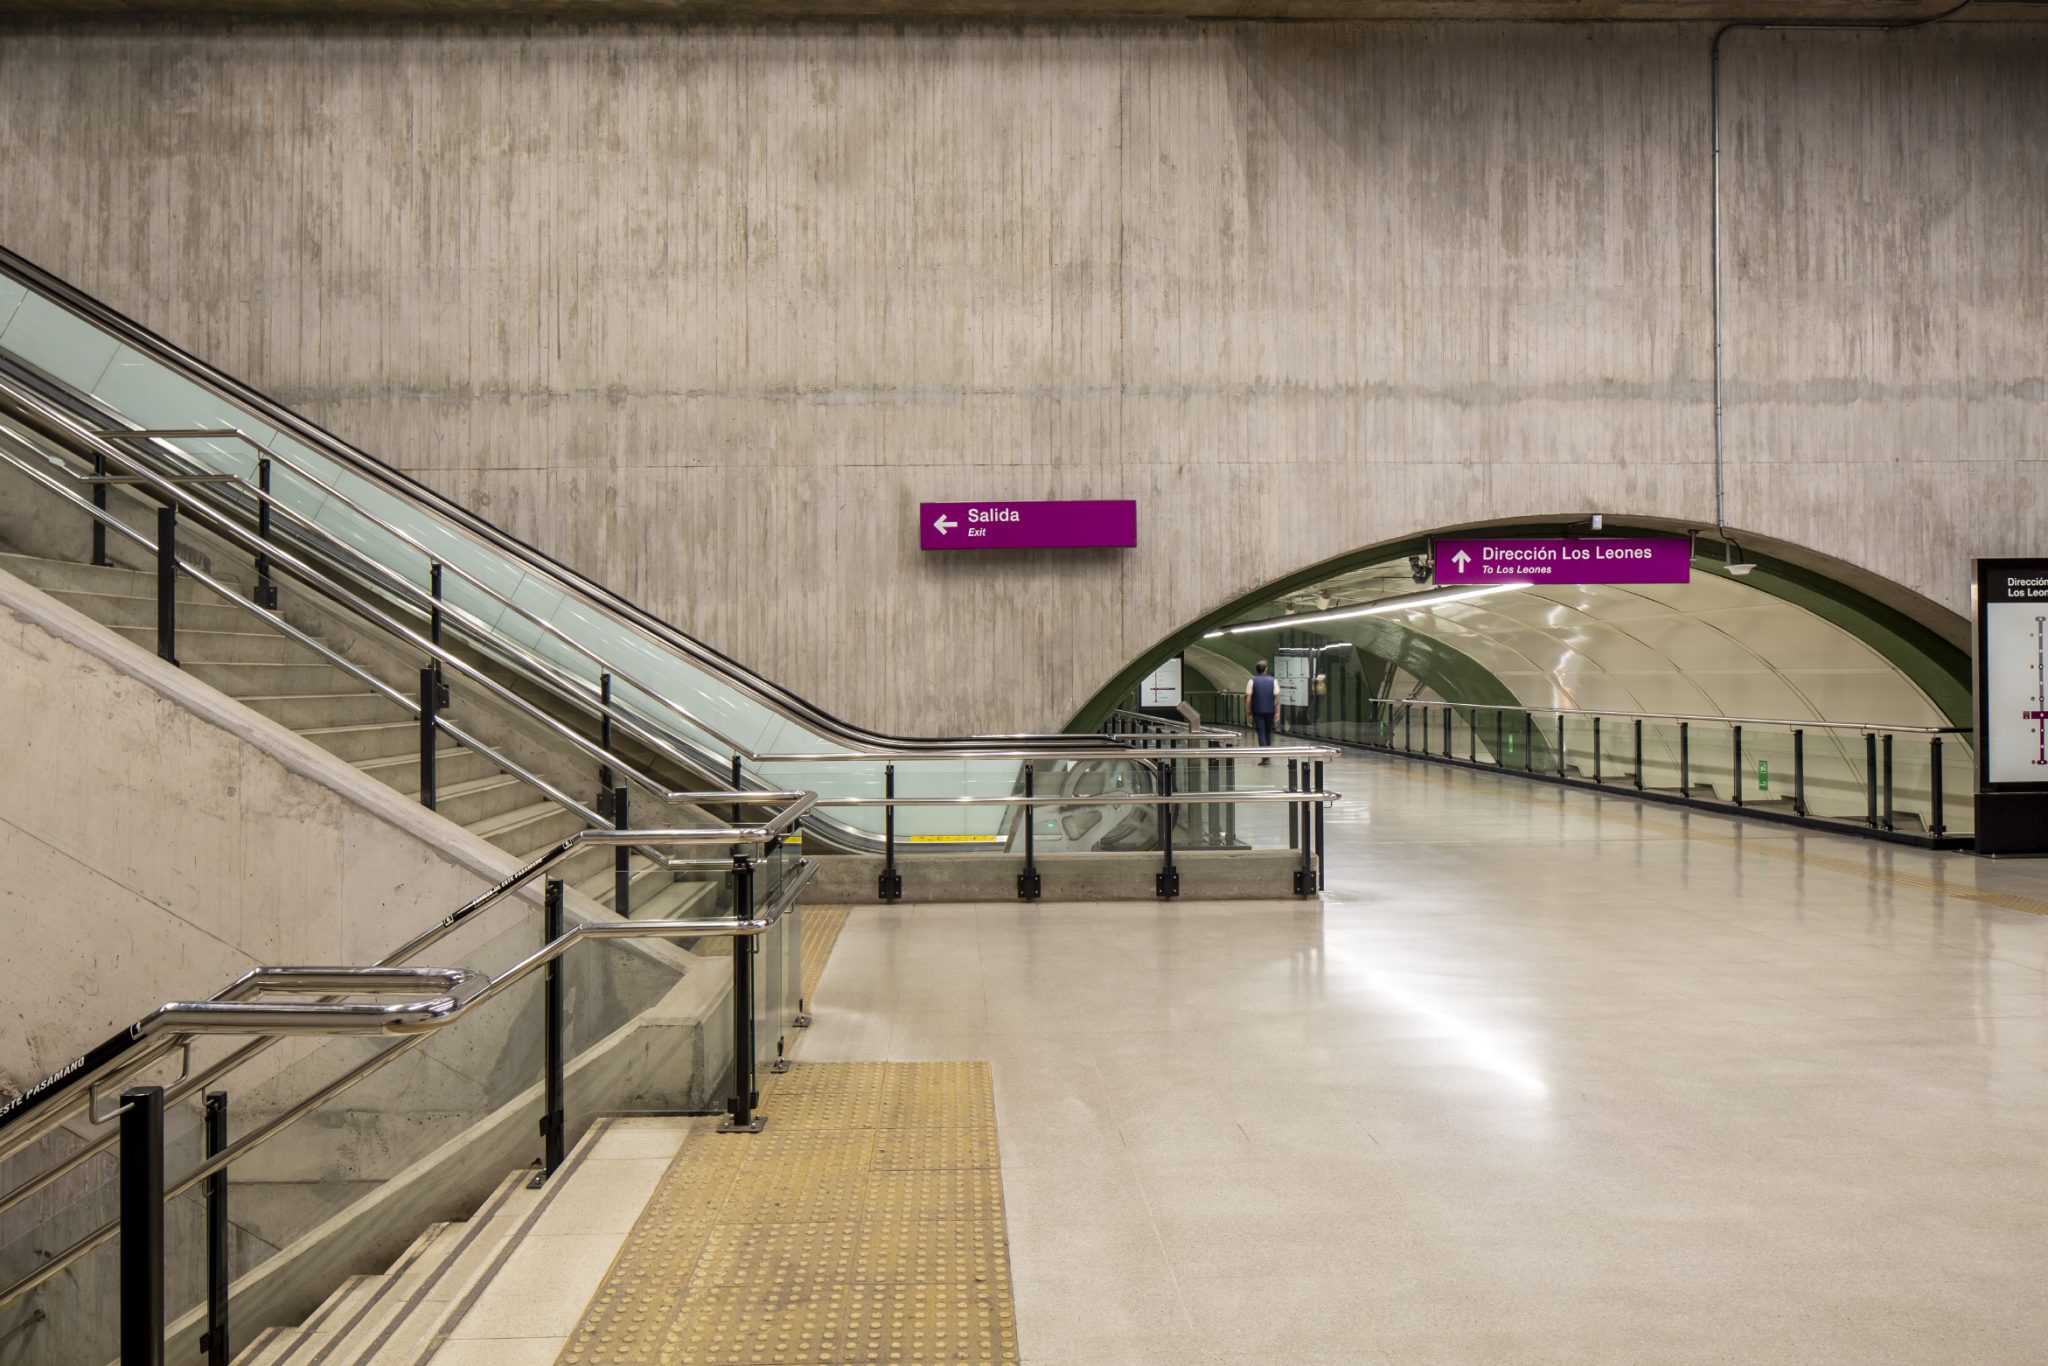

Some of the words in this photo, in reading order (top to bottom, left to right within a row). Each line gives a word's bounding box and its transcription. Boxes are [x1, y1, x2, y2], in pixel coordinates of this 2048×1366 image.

[968, 508, 1020, 522] Salida
[968, 528, 986, 537] Exit
[1482, 546, 1557, 561] Dirección
[1562, 546, 1590, 560] Los
[1596, 546, 1652, 560] Leones
[1482, 565, 1494, 574] To
[1496, 565, 1514, 574] Los
[1516, 564, 1552, 574] Leones
[2007, 588, 2025, 597] Los
[25, 1056, 85, 1100] PASAMANO
